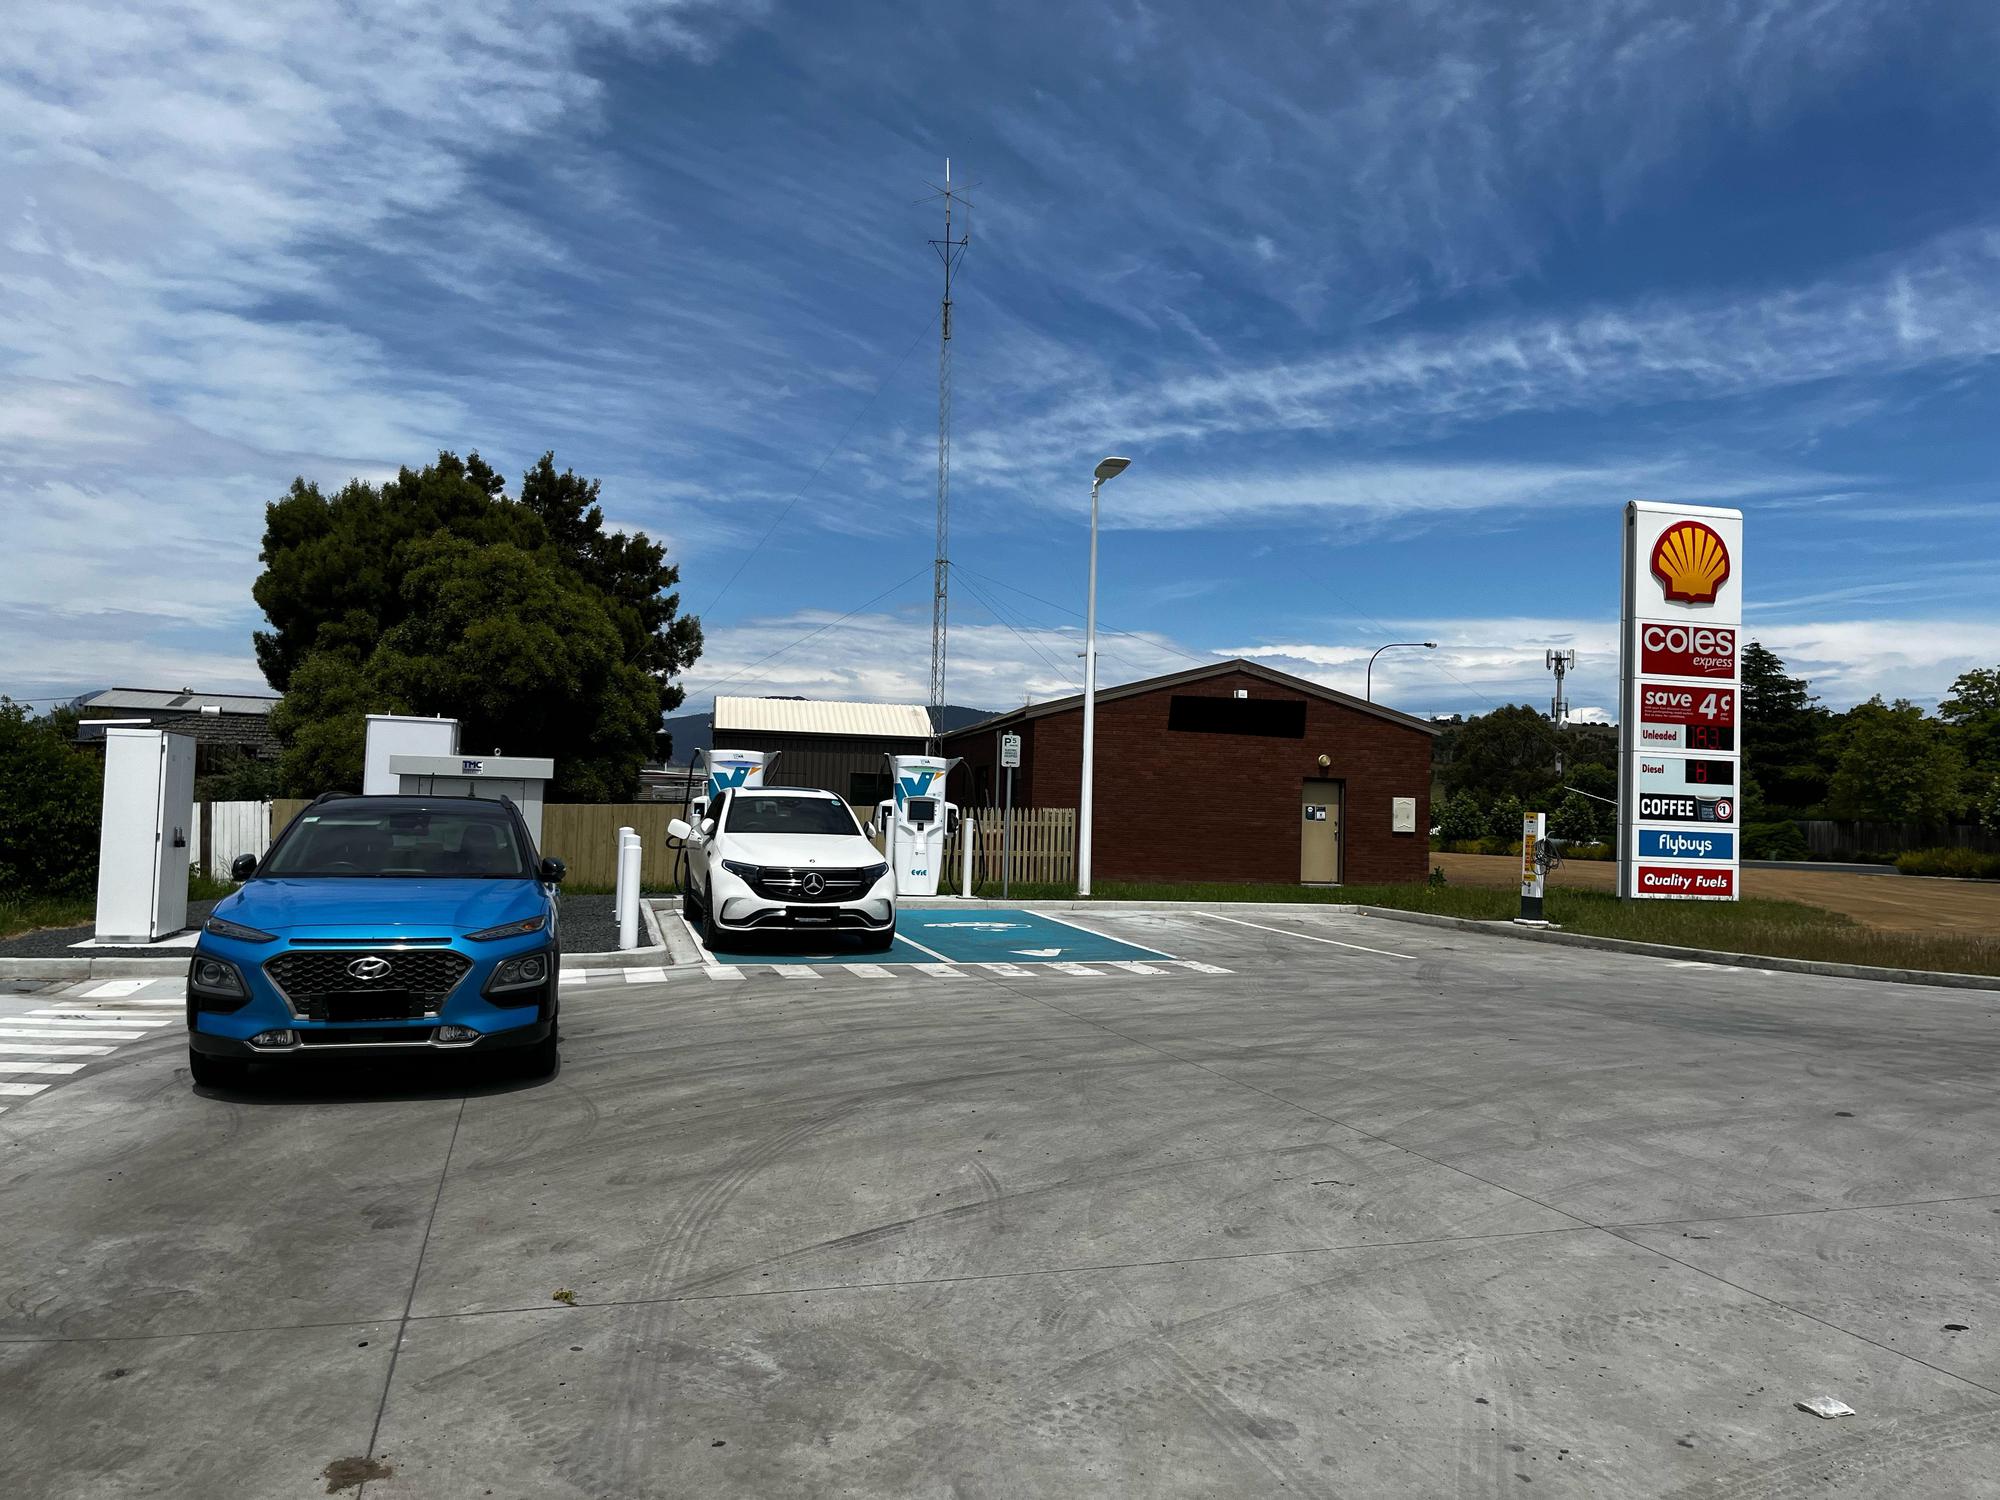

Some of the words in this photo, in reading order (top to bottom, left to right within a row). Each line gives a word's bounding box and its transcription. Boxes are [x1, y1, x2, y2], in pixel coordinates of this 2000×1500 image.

[1644, 626, 1733, 656] coles
[1693, 656, 1733, 669] express
[1645, 691, 1693, 707] save
[1642, 729, 1677, 741] Unleaded
[463, 760, 482, 769] TMC
[1642, 763, 1664, 774] Diesel
[1641, 798, 1694, 817] COFFEE
[1659, 833, 1713, 856] flybuys
[1644, 873, 1692, 890] Quality
[1696, 875, 1728, 888] Fuels
